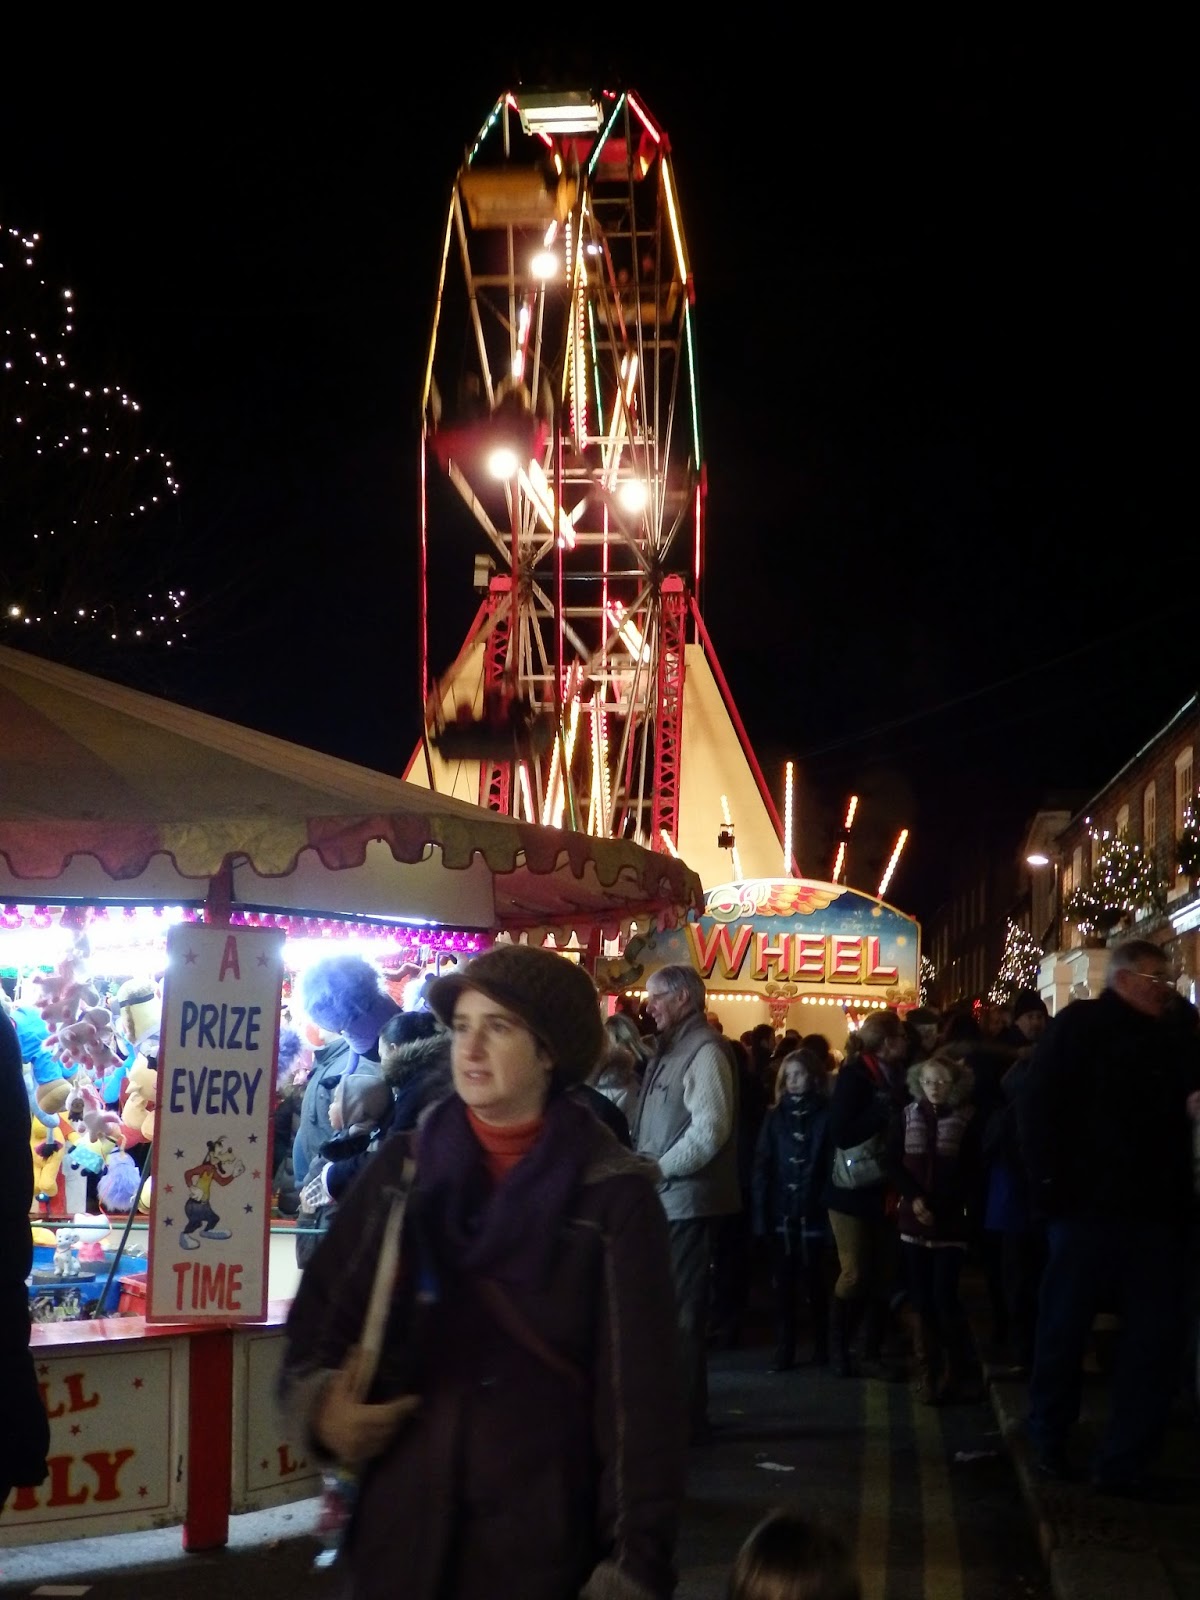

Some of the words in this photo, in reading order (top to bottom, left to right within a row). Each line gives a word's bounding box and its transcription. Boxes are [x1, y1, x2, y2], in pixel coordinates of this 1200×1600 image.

[219, 934, 241, 982] A
[687, 922, 900, 984] WHEEL
[180, 1000, 262, 1051] PRIZE
[169, 1066, 263, 1117] EVERY
[172, 1261, 245, 1311] TIME
